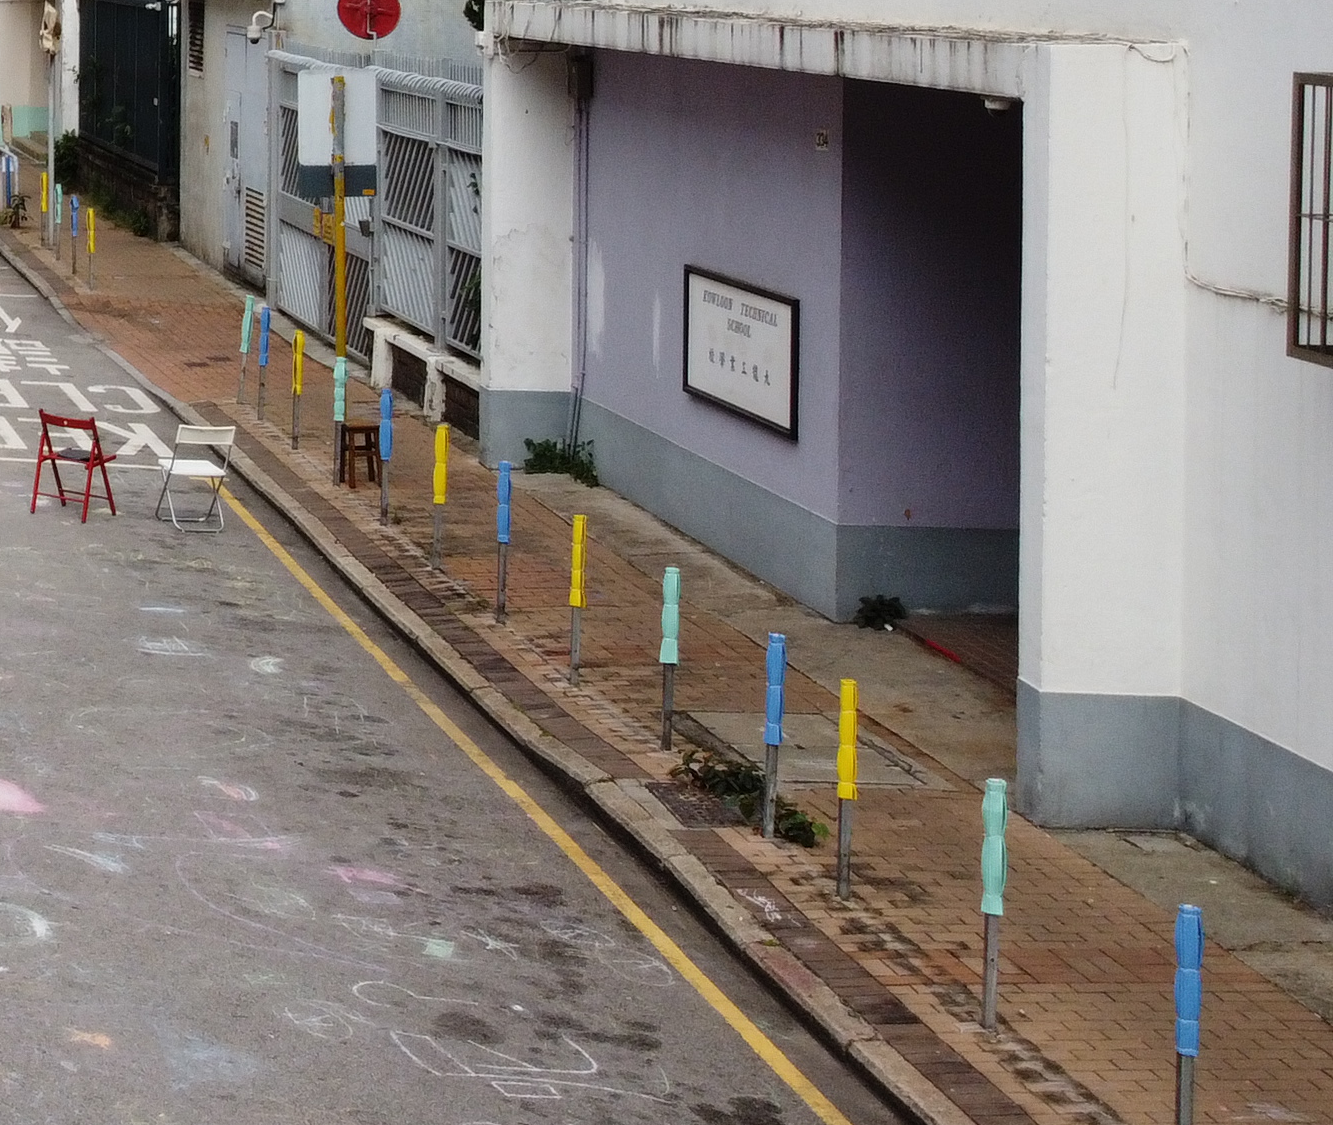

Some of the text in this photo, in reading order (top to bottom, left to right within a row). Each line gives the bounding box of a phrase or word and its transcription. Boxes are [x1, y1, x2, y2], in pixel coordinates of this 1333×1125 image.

[703, 290, 778, 327] KOWLOON TECHNICAL
[727, 318, 751, 338] SCHOOL
